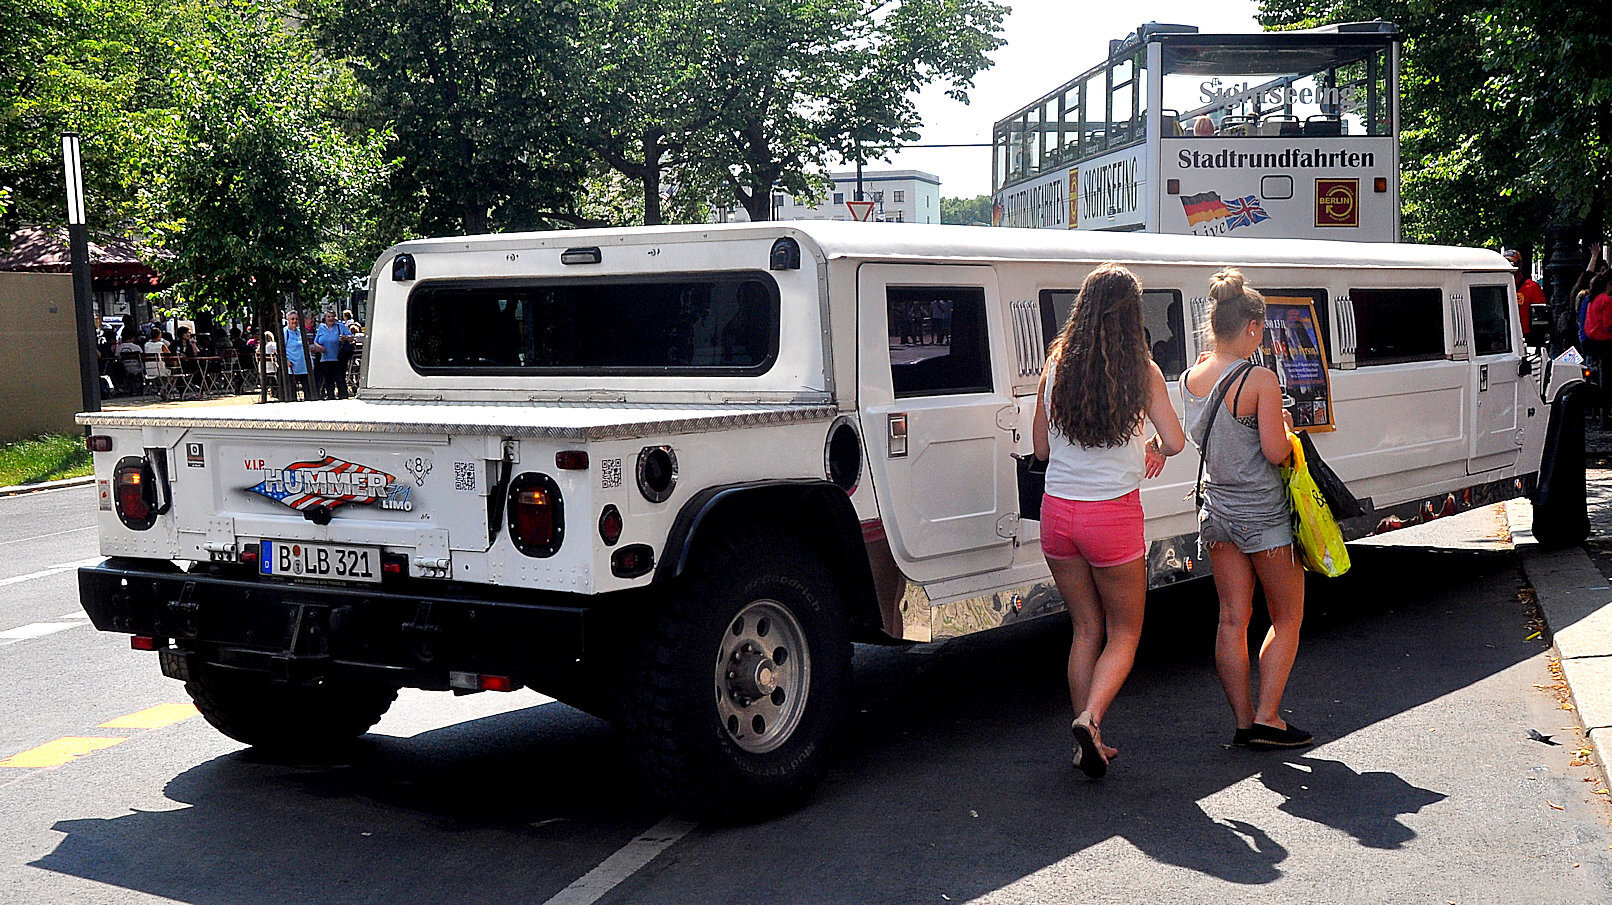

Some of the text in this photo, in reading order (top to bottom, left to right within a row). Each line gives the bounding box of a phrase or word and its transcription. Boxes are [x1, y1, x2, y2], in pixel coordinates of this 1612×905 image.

[1199, 81, 1356, 110] Sightseeing
[1178, 149, 1375, 168] Stadtrundfahrten
[1083, 156, 1138, 220] SIGHTSEEING
[1319, 197, 1350, 205] BERLIN
[244, 459, 266, 471] V.I.P.
[264, 468, 388, 498] HUMMER
[382, 499, 413, 512] LIMO
[264, 560, 270, 569] D
[279, 545, 373, 578] B LB 321
